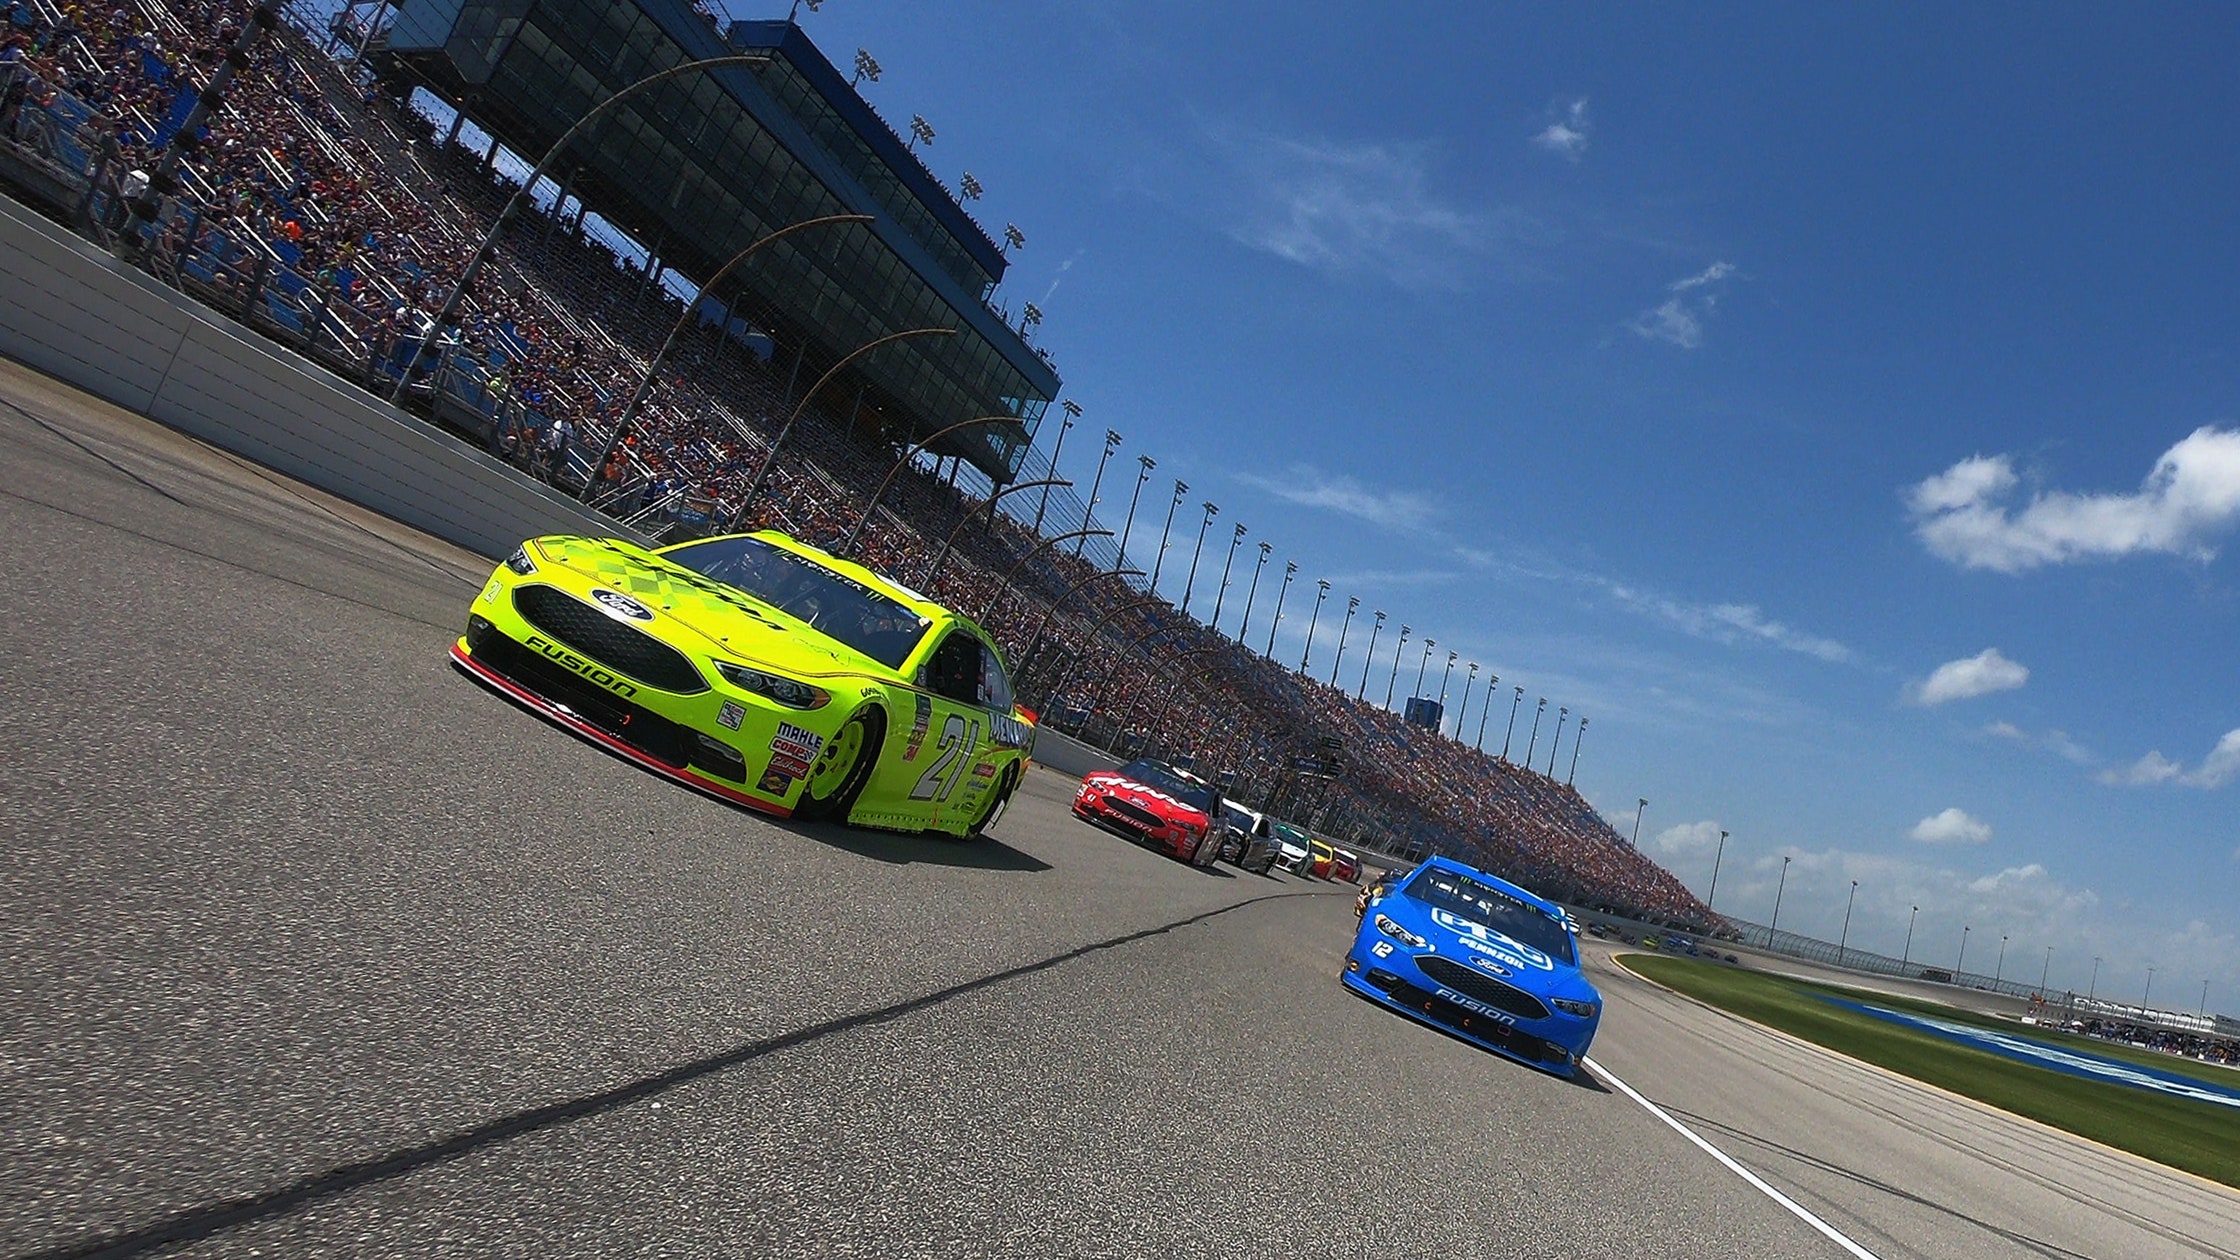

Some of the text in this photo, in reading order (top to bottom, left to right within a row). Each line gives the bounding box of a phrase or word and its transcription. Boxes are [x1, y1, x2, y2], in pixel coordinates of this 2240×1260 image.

[794, 556, 864, 592] MONSTER
[598, 593, 644, 617] Ford
[524, 636, 638, 698] FUSION
[772, 739, 807, 757] COMP
[777, 721, 824, 750] MAHLE
[908, 713, 979, 803] 21
[1104, 808, 1153, 833] FUSION
[1371, 940, 1394, 959] 12
[1458, 936, 1526, 970] PENNZOIL
[1435, 988, 1517, 1026] FUSION
